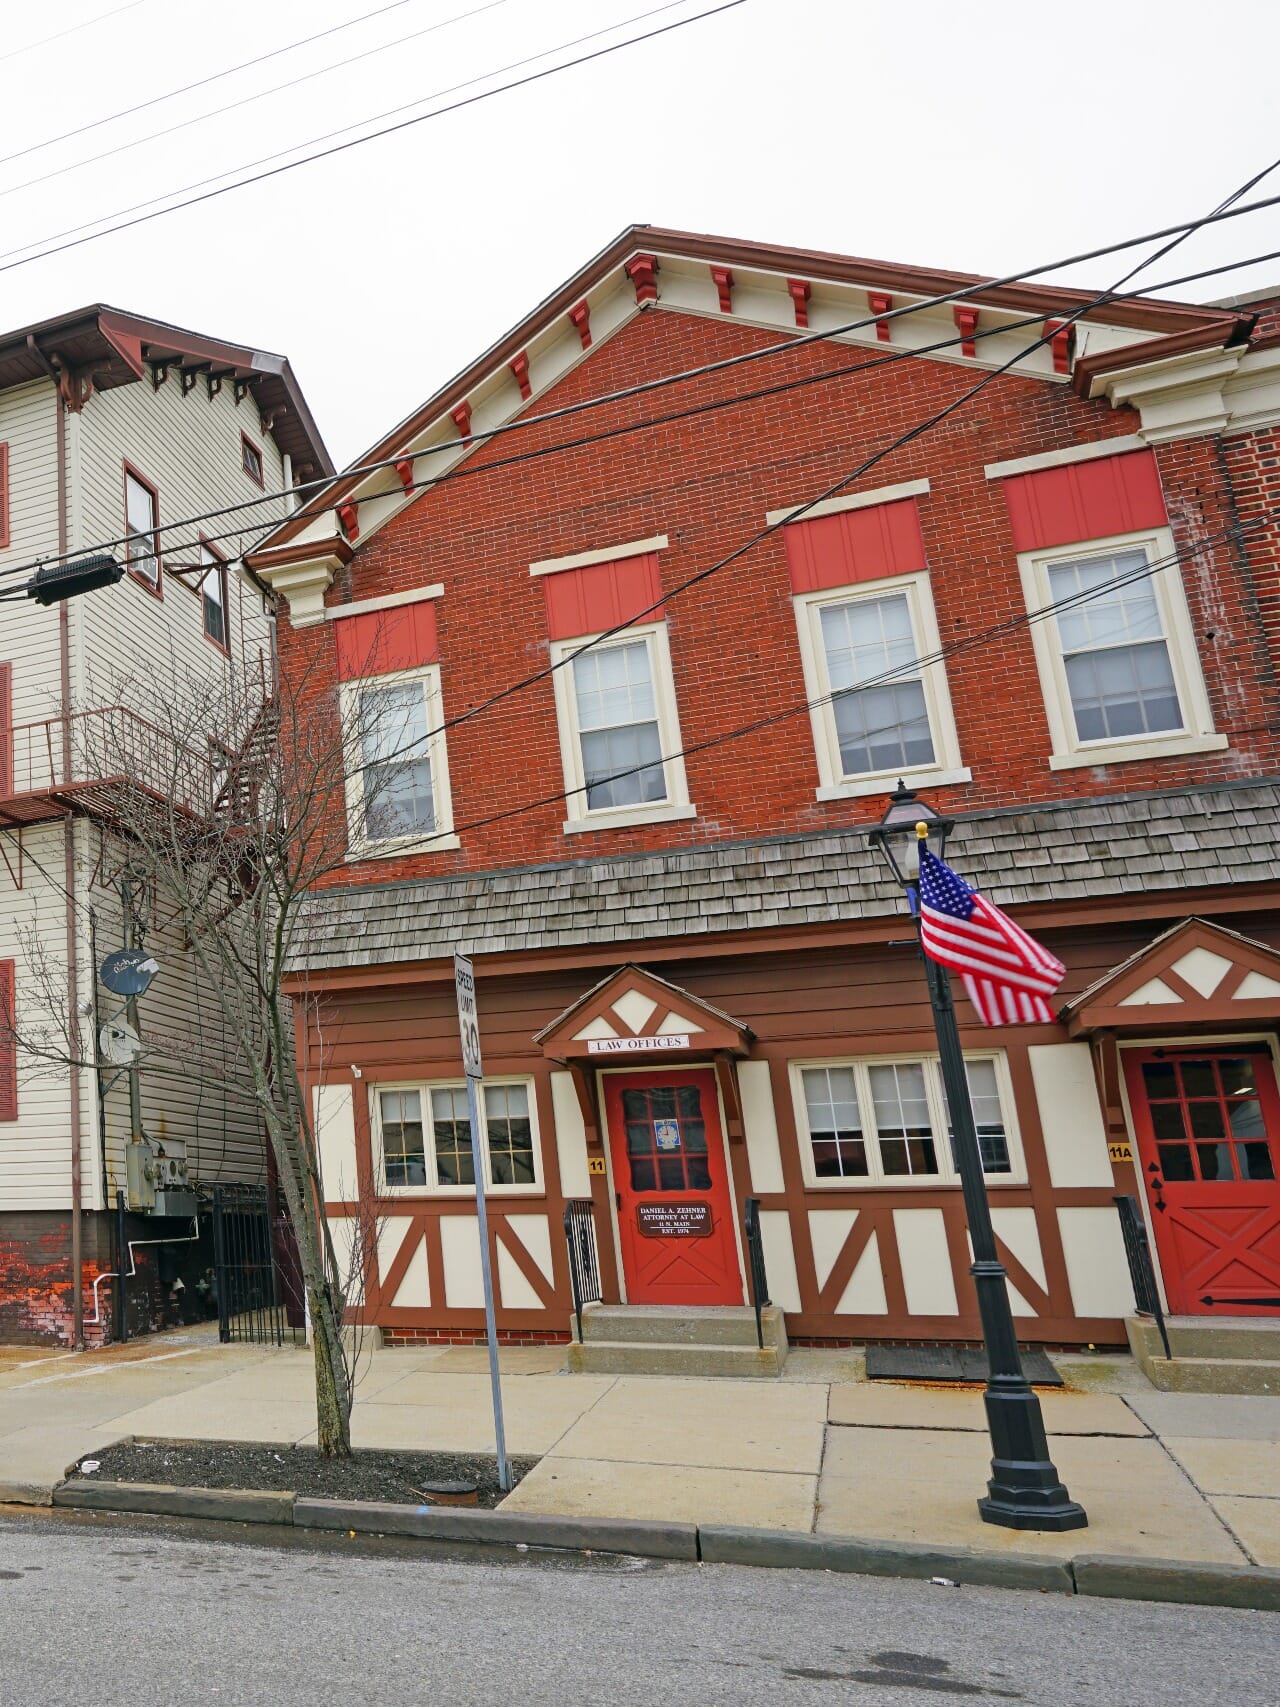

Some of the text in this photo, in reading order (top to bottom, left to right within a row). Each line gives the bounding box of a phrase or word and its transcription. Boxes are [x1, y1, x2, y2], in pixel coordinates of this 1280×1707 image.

[458, 968, 473, 993] SPEED
[596, 1037, 681, 1051] LAW OFFICES
[1109, 1146, 1132, 1158] 11A
[590, 1160, 603, 1171] 11
